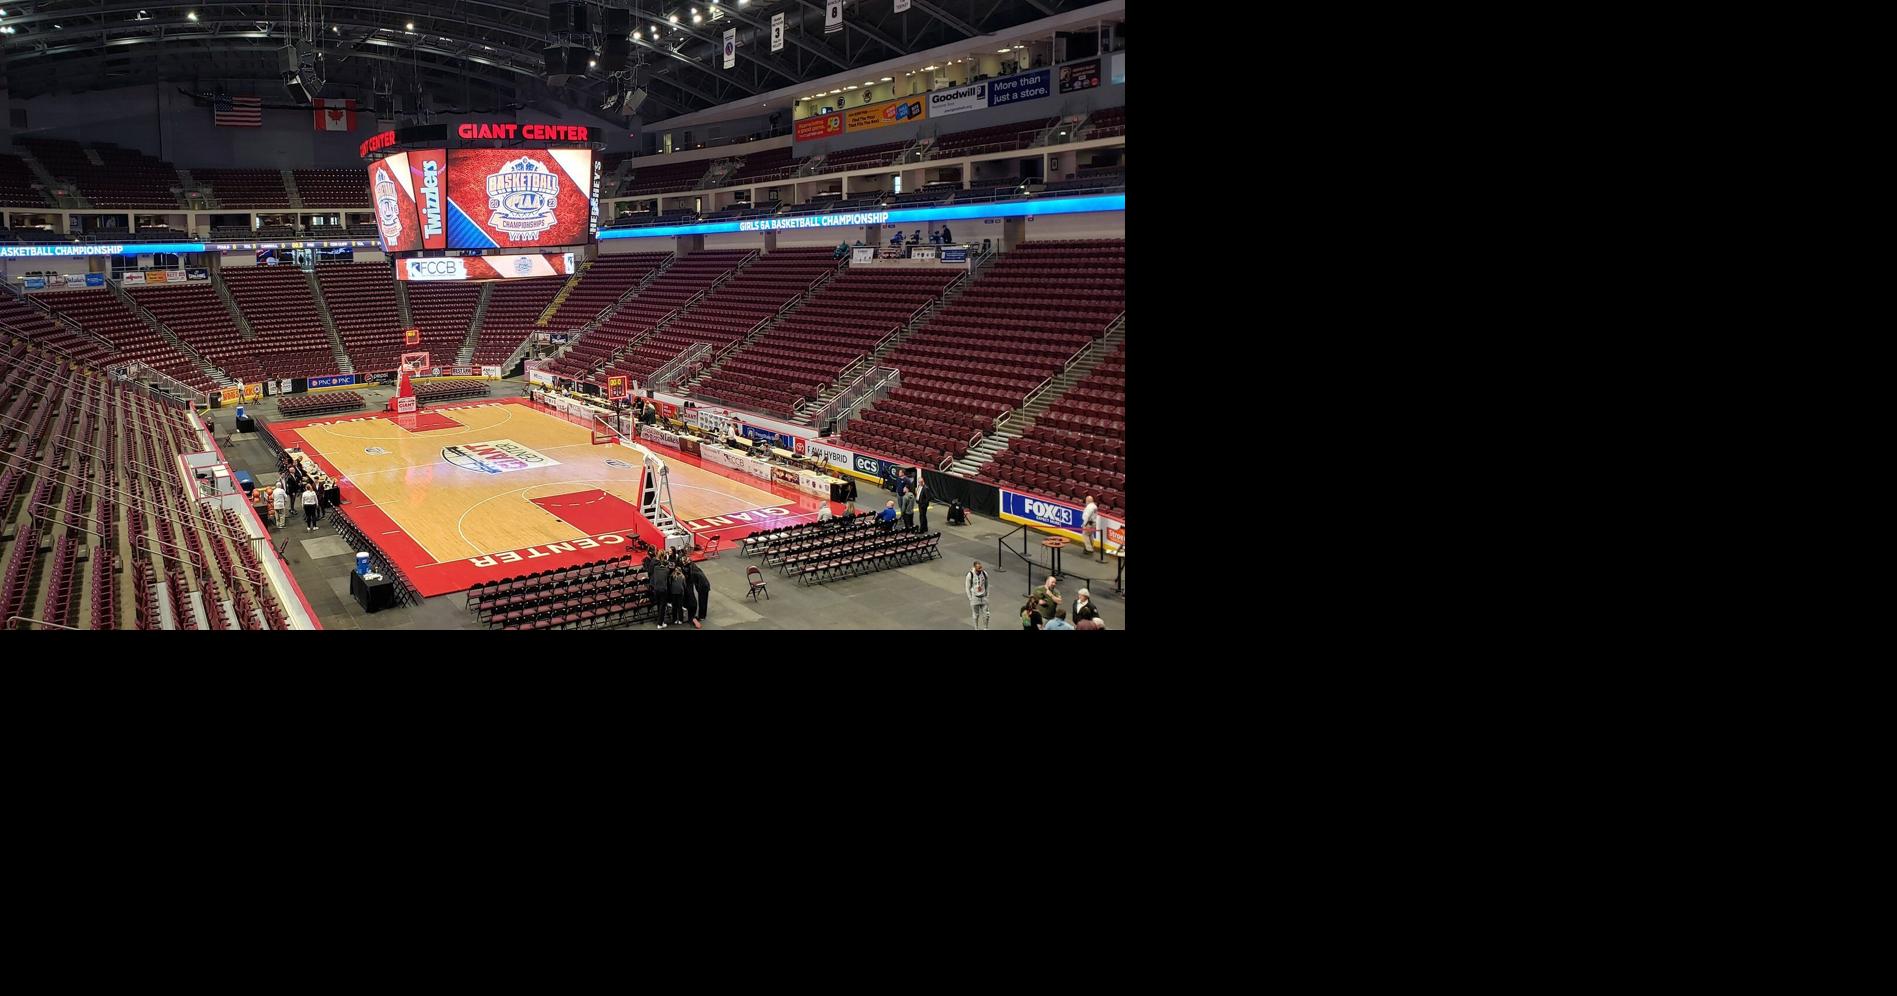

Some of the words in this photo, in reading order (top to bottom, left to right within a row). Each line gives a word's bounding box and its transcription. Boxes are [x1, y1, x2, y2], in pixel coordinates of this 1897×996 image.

[831, 6, 838, 18] 8
[774, 27, 780, 39] 3
[994, 80, 1018, 91] More
[1019, 75, 1041, 86] than
[932, 87, 976, 104] Goodwill
[993, 91, 1010, 104] just
[1012, 92, 1018, 100] a
[1019, 86, 1048, 98] store.
[368, 130, 396, 151] CENTER
[458, 123, 518, 140] GIANT
[521, 125, 588, 141] CENTER
[489, 172, 558, 193] BASKETBALL
[419, 160, 443, 240] Twizzlers
[502, 219, 545, 229] CHAMPIONSHIPS
[740, 222, 760, 232] GIRLS
[760, 221, 771, 230] 6A
[771, 217, 820, 230] BASKETBALL
[821, 212, 889, 227] CHAMPIONSHIP
[54, 245, 123, 256] CHAMPIONSHIP
[420, 261, 456, 274] FCCB
[463, 444, 528, 470] GIANT
[495, 443, 544, 463] CENTER
[823, 449, 848, 464] HYBRID
[857, 459, 877, 473] ecs
[688, 507, 790, 531] GIANT
[1024, 498, 1073, 525] FOX43
[469, 533, 625, 568] CENTER
